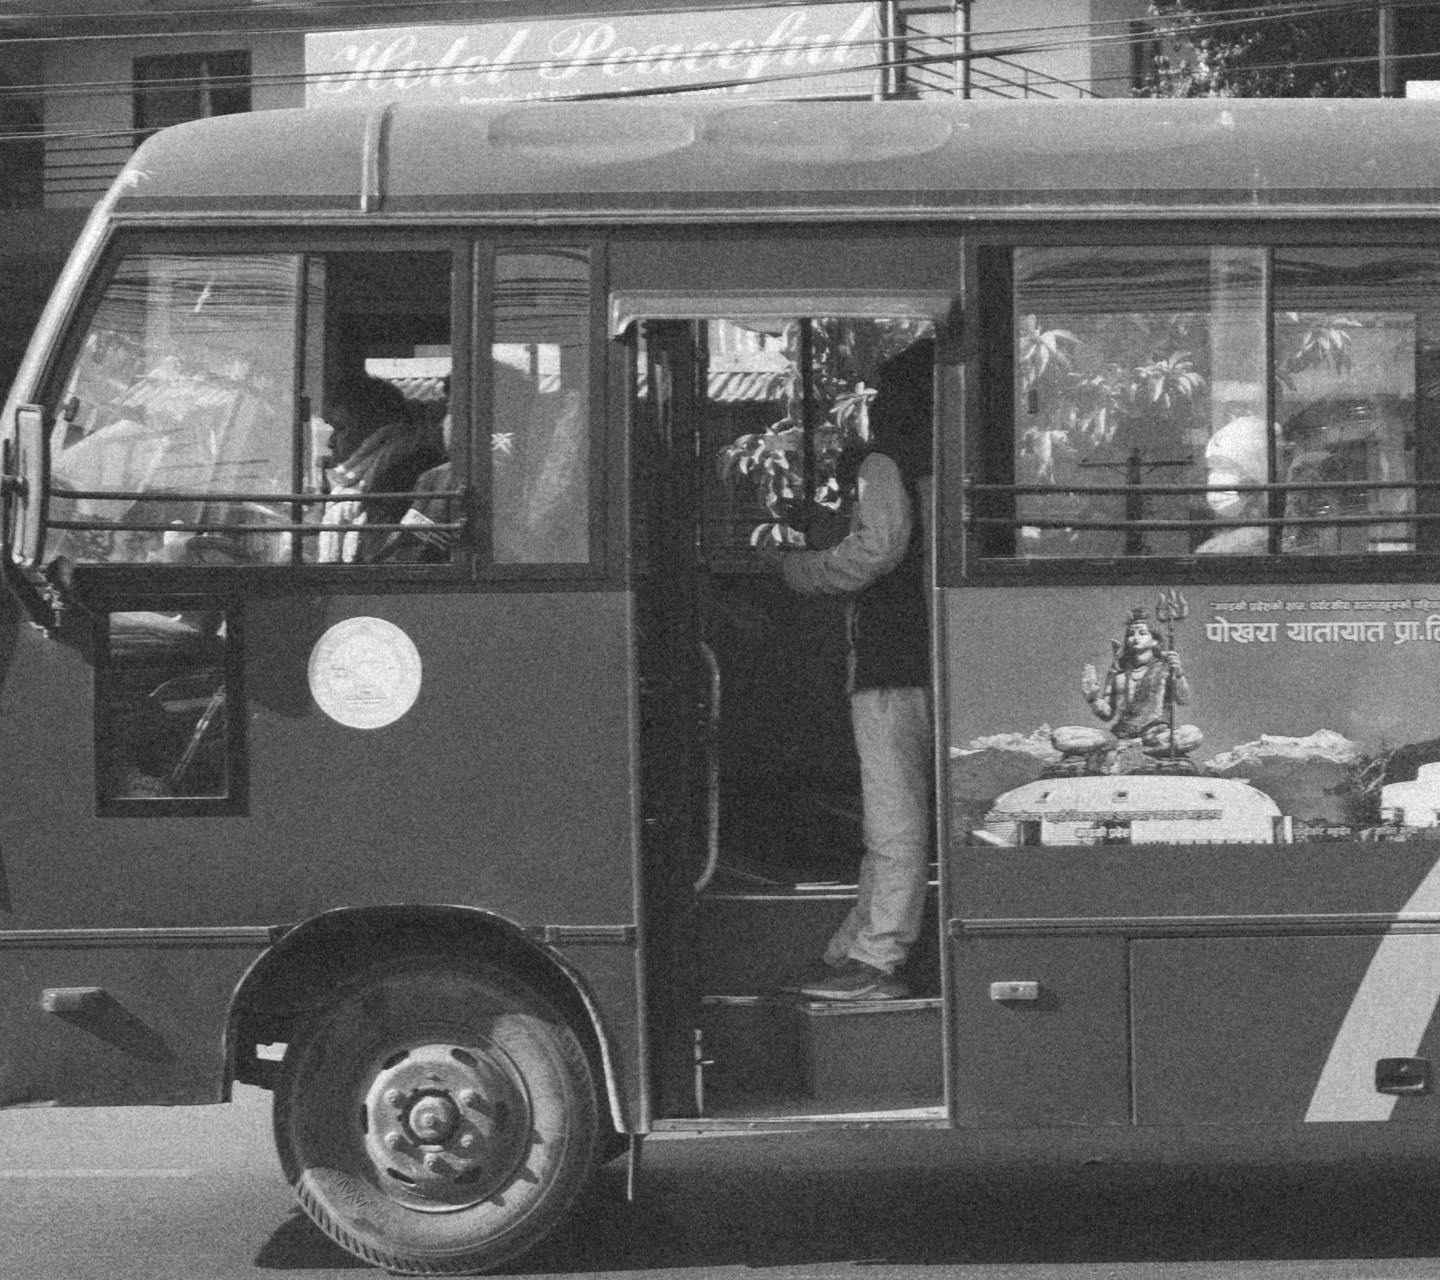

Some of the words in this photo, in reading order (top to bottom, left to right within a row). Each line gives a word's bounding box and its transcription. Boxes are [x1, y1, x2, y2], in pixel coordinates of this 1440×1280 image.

[318, 27, 531, 94] Hotel
[537, 4, 875, 94] Peaceful
[1205, 616, 1280, 644] पोखरा
[1286, 620, 1388, 643] यातायात
